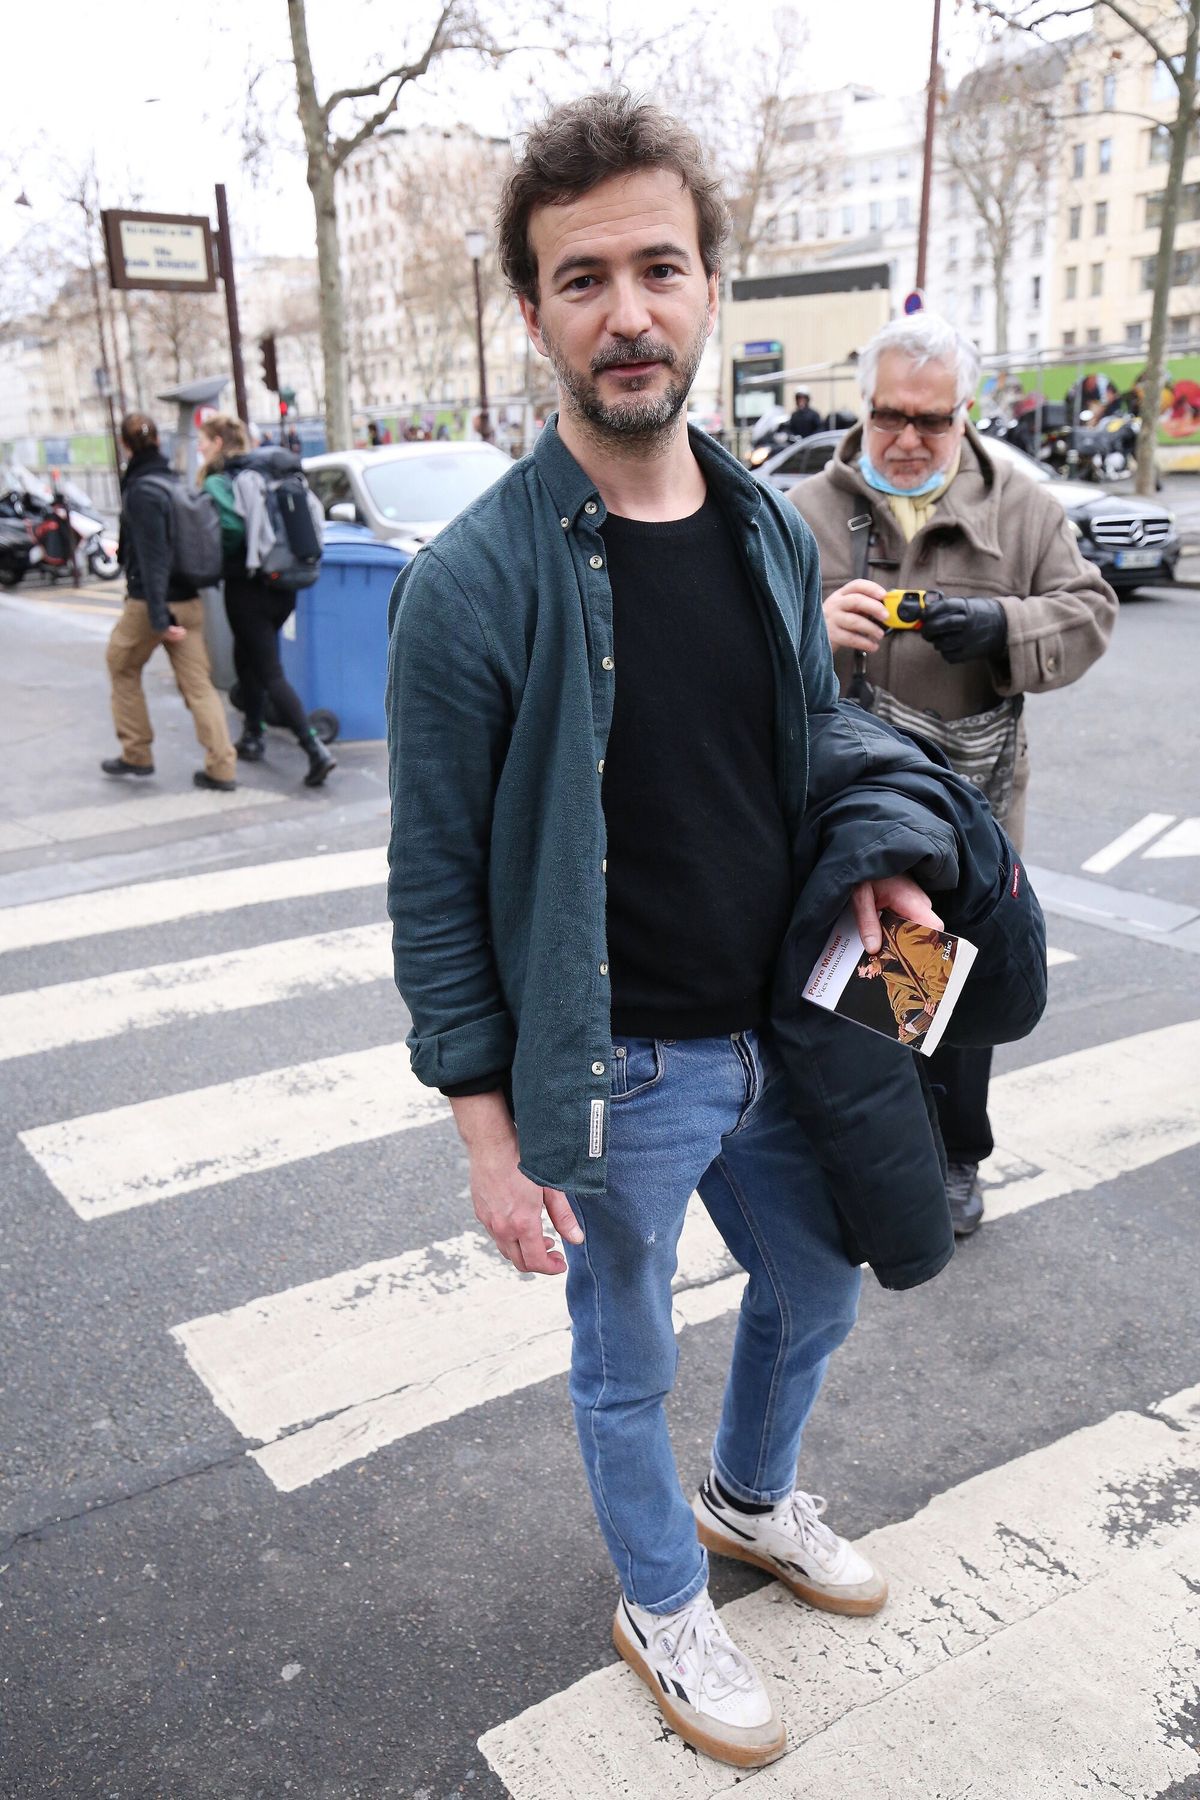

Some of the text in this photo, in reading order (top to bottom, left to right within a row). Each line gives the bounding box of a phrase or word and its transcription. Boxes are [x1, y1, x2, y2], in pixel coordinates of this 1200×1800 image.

[808, 935, 842, 996] Pierre Michon
[816, 938, 850, 998] Vies minuscules
[941, 940, 953, 961] folio
